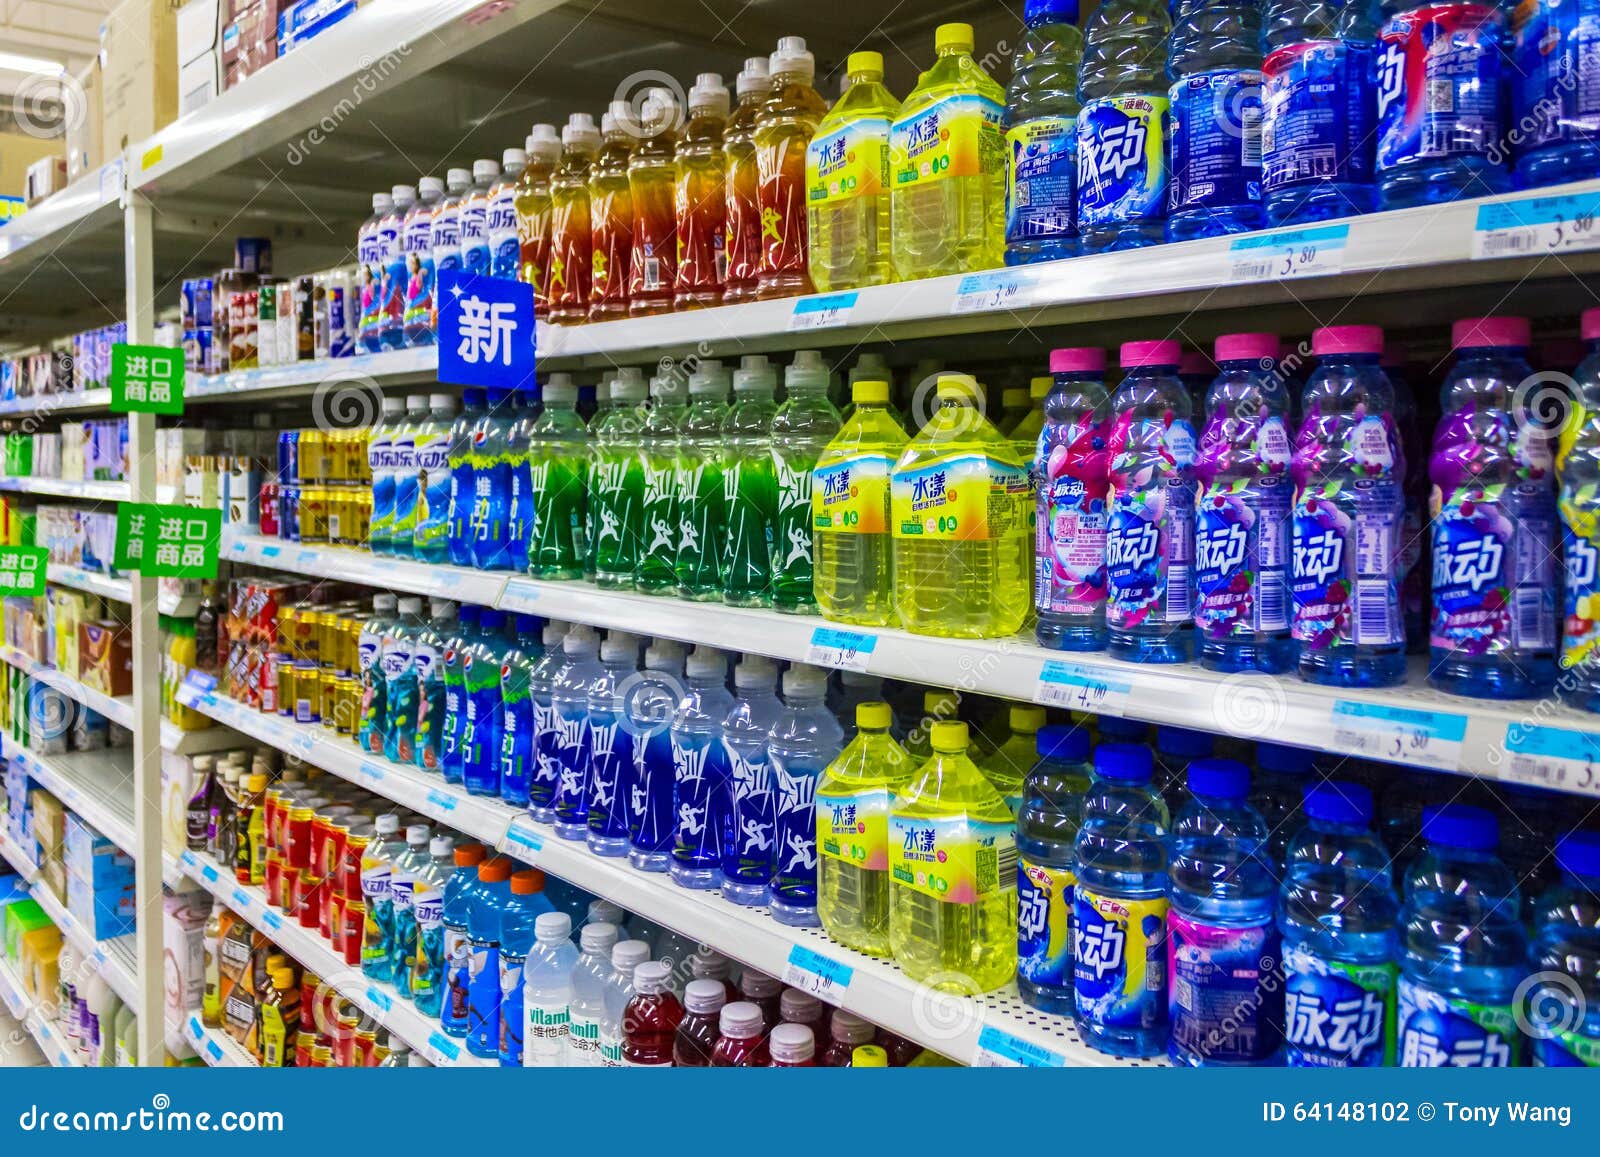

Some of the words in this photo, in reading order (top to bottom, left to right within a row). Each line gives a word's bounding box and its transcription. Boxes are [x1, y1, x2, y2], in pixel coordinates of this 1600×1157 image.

[908, 112, 939, 150] 水漾
[818, 136, 846, 169] 水漾
[1281, 246, 1316, 276] 3.80
[457, 295, 518, 366] 新
[125, 355, 172, 378] 进口
[124, 381, 171, 403] 商品
[824, 469, 850, 497] 水漾
[912, 471, 947, 502] 水漾
[158, 518, 207, 541] 进口
[156, 543, 204, 566] 商品
[1107, 522, 1159, 570] 脉动
[1196, 523, 1247, 576] 脉动
[1432, 535, 1503, 592] 脉动
[1078, 681, 1107, 707] 4.00
[832, 804, 857, 826] 水漾
[903, 827, 936, 853] 水漾
[1286, 992, 1384, 1061] 脉动
